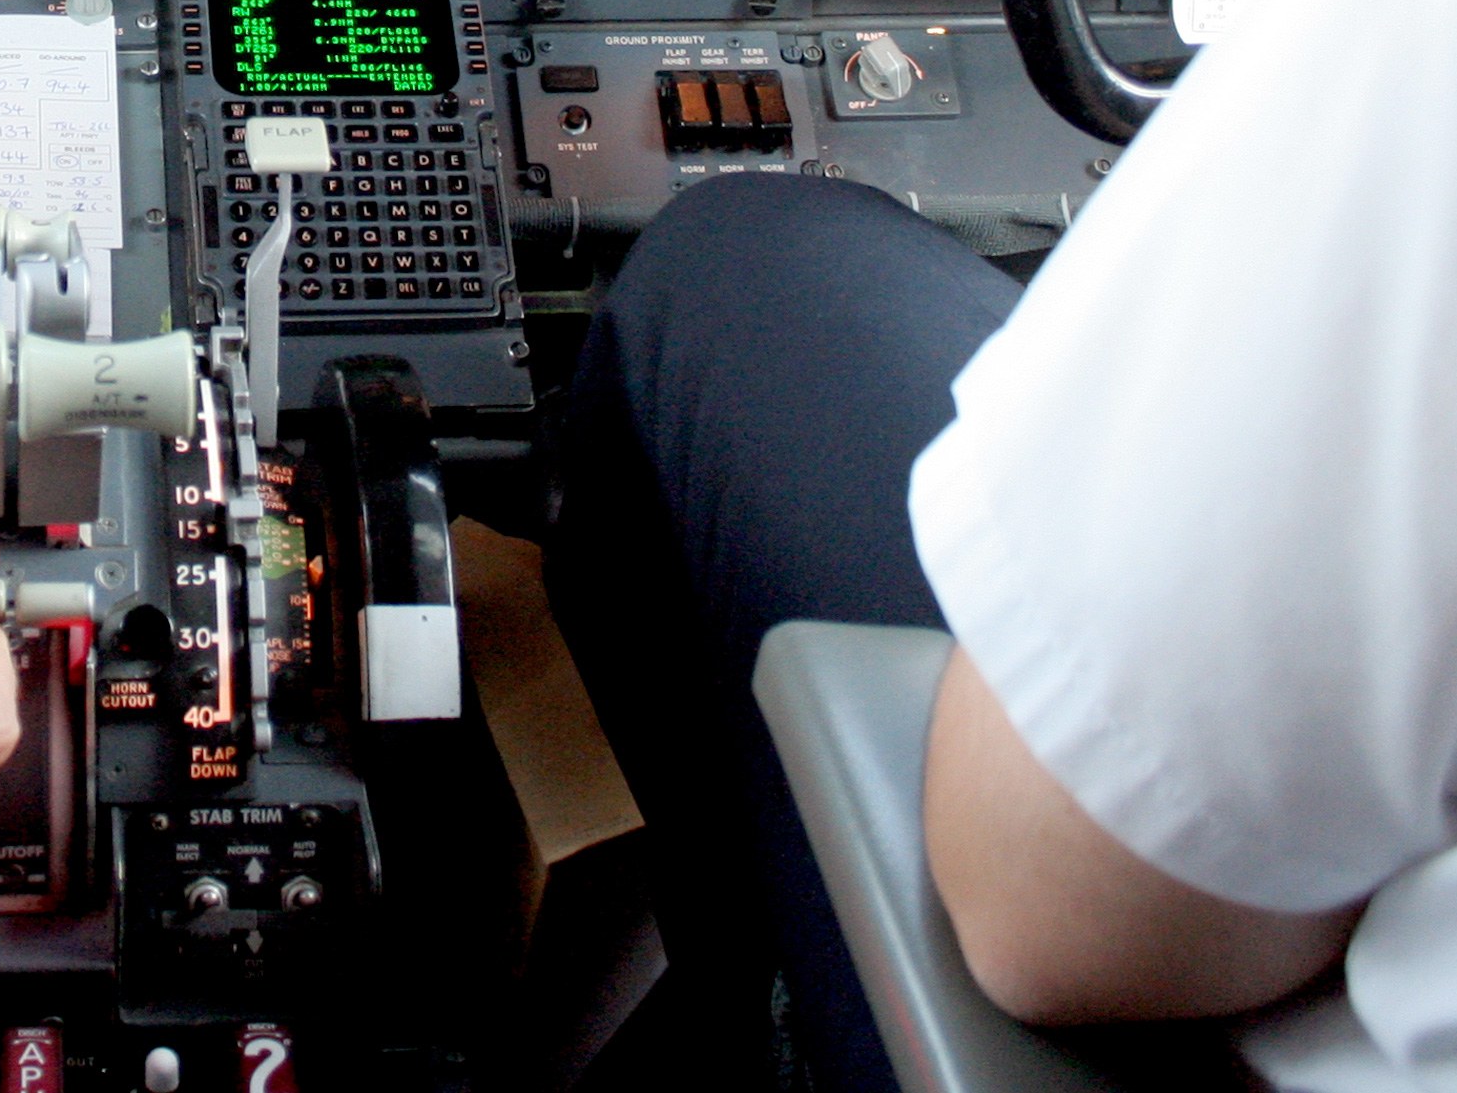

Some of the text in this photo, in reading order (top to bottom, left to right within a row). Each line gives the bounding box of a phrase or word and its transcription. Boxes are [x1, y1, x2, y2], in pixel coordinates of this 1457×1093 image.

[605, 36, 706, 46] GROUND PROXIMITY
[263, 127, 313, 137] FLAP
[680, 165, 705, 174] NORM
[93, 354, 117, 385] 2
[175, 486, 200, 504] 10
[178, 521, 201, 539] 15
[176, 565, 206, 585] 25
[178, 628, 211, 649] 30
[111, 683, 148, 695] HORN
[101, 694, 155, 708] CUTOUT
[183, 707, 214, 728] 40
[192, 746, 236, 762] FLAP
[190, 763, 238, 778] DOWN
[190, 808, 283, 825] STAB TRIM
[226, 845, 271, 855] NORMAL
[244, 1038, 287, 1093] 2
